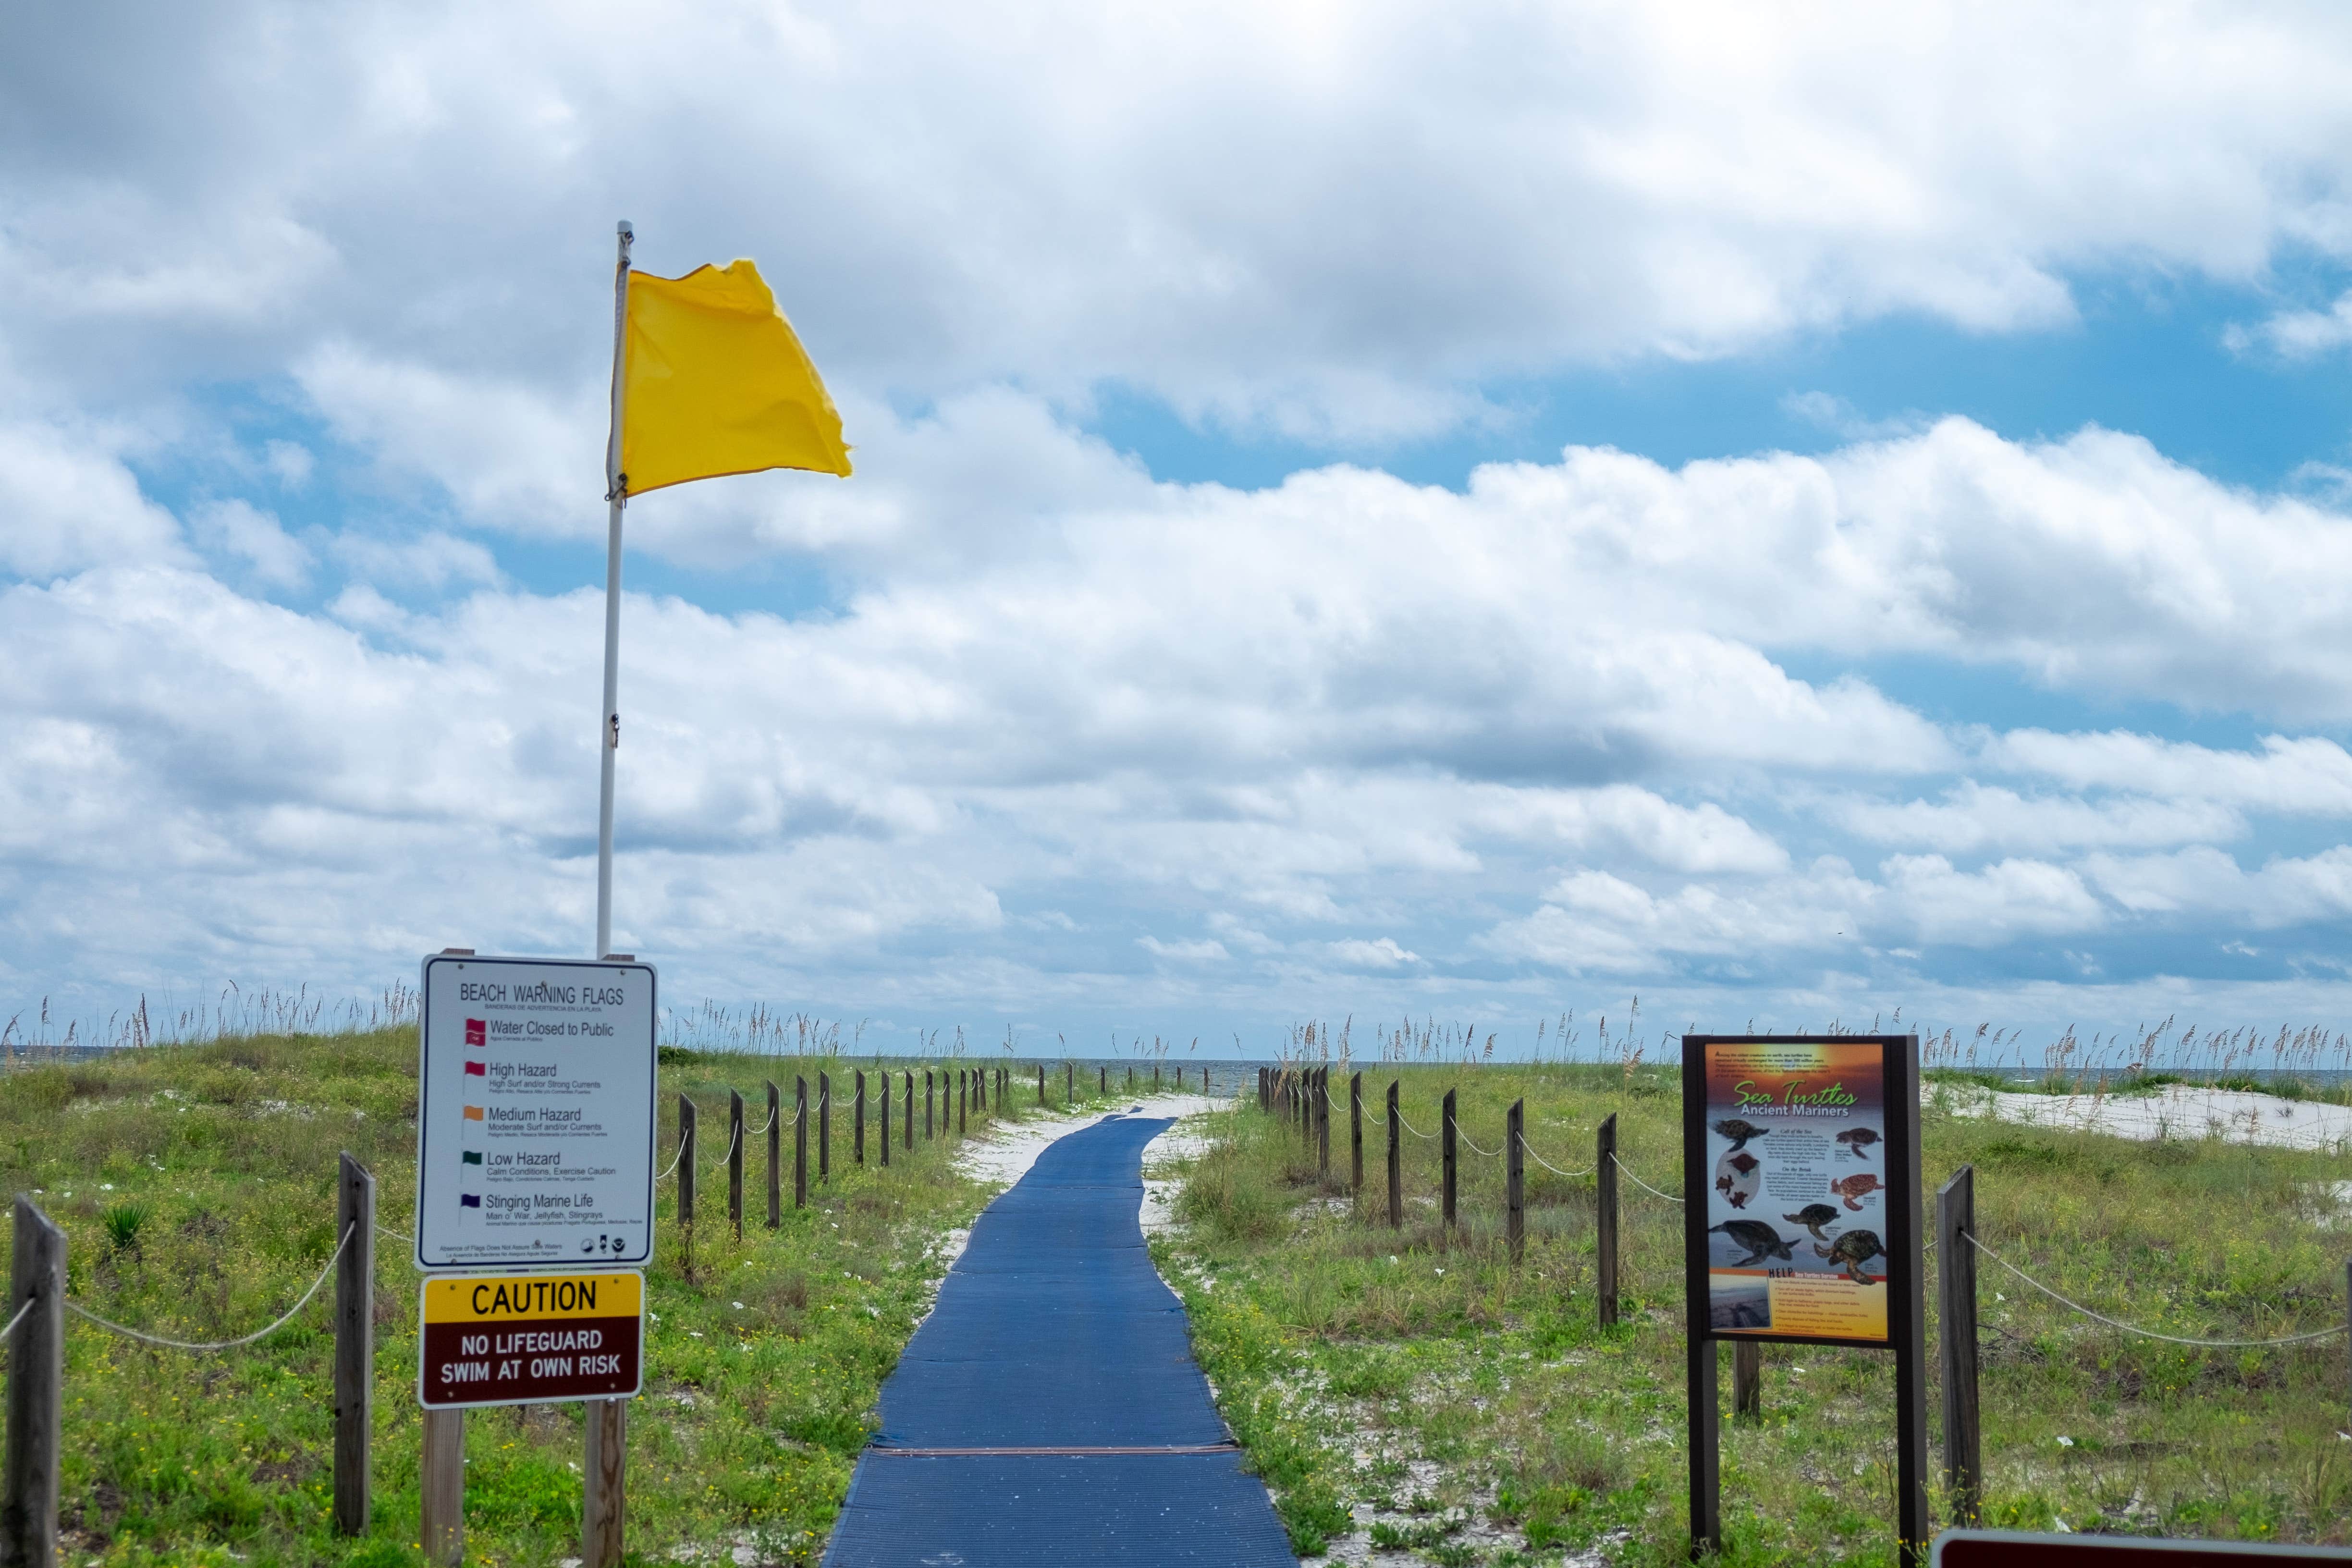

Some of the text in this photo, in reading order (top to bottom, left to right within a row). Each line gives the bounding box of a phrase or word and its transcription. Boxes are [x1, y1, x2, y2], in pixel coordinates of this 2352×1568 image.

[460, 984, 624, 1005] BEACH WARNING FLAGS
[490, 1020, 613, 1036] Water Closed to Public
[490, 1063, 556, 1079] High Hazard
[489, 1080, 504, 1089] High
[548, 1081, 570, 1089] Strong
[1734, 1079, 1858, 1107] Sea Turtles
[489, 1107, 581, 1121] Medium Hazard
[1740, 1103, 1849, 1117] Ancient Mariners
[488, 1152, 561, 1165] Low Hazard
[486, 1194, 593, 1211] Stinging Marine Life
[568, 1211, 602, 1220] Stingrays
[1769, 1268, 1793, 1278] HELP
[472, 1281, 596, 1315] CAUTION
[462, 1330, 602, 1356] NO LIFEGUARD
[441, 1354, 621, 1383] SWIM AT OWN RISK
